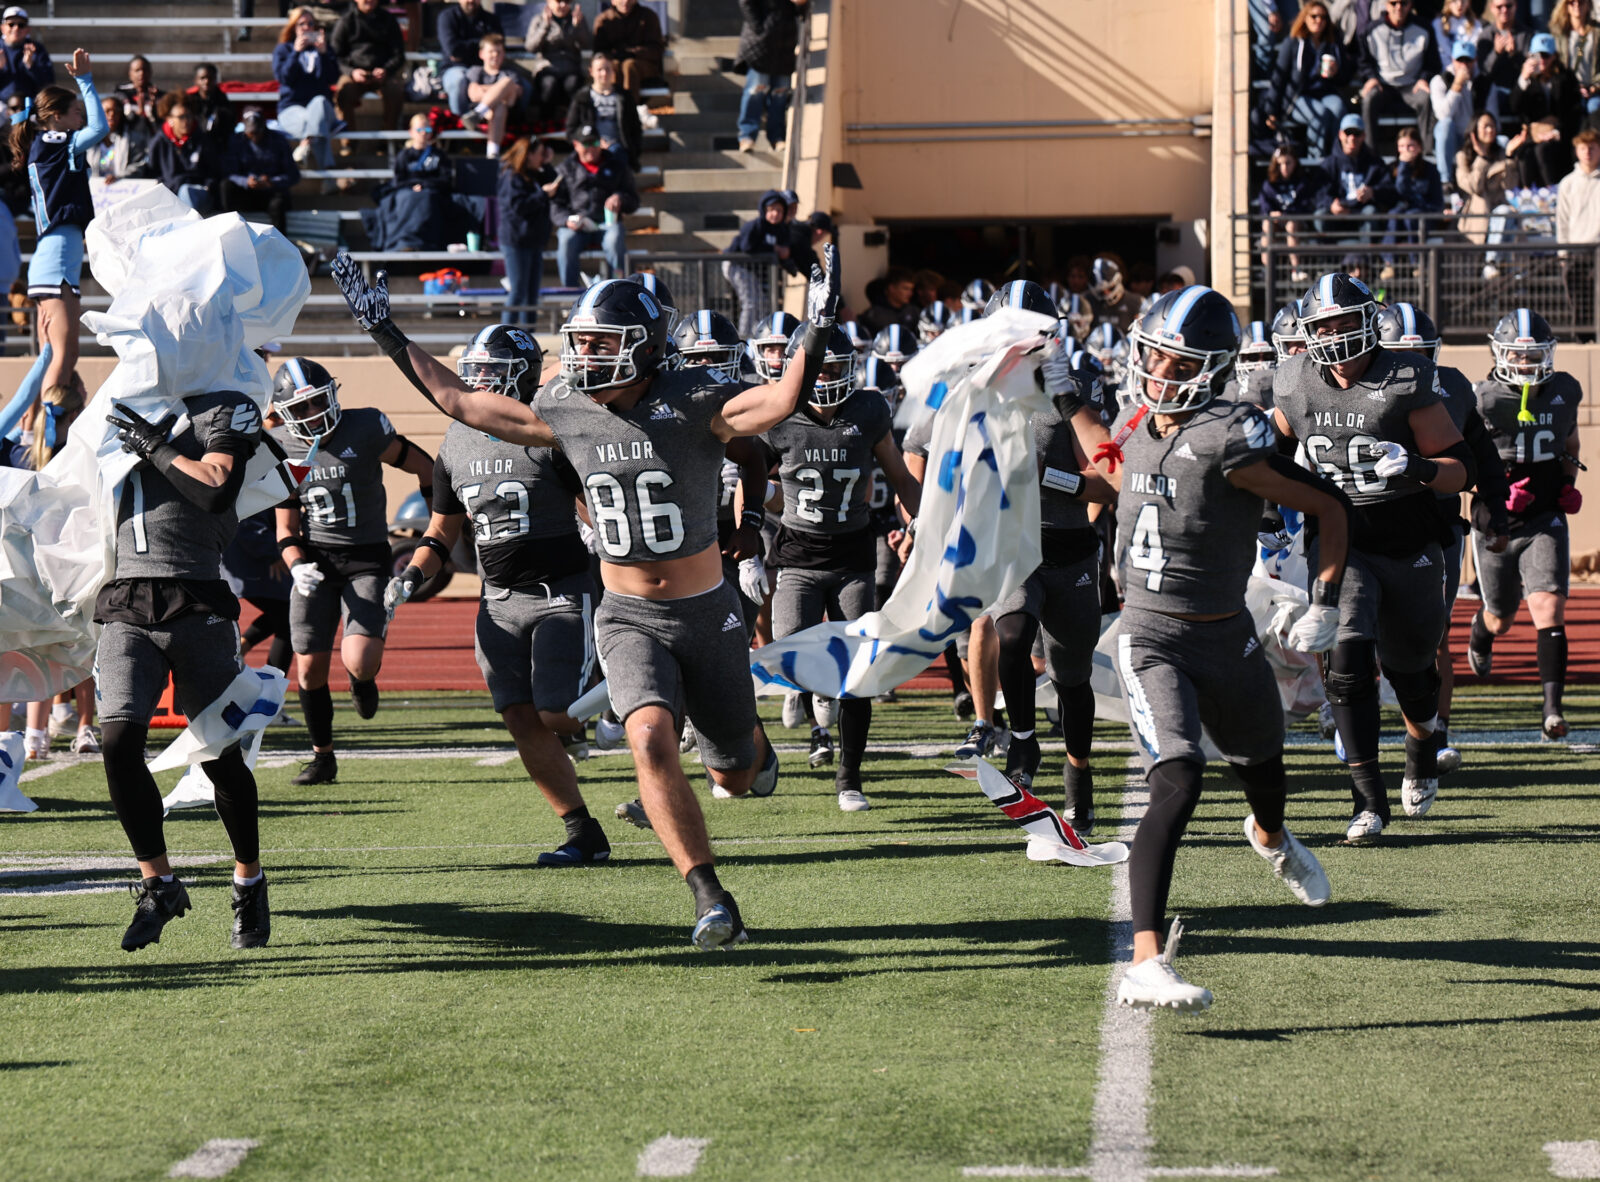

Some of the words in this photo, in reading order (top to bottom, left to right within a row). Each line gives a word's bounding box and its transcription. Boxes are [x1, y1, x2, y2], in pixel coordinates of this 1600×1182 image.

[506, 329, 534, 351] 53
[650, 411, 678, 420] adidas
[1314, 412, 1365, 429] VALOR
[596, 440, 654, 463] VALOR
[804, 448, 847, 462] VALOR
[469, 458, 513, 476] VALOR
[796, 467, 860, 524] 27
[1131, 472, 1178, 498] VALOR
[129, 469, 149, 554] 1
[460, 480, 531, 542] 53
[586, 469, 686, 557] 86
[1129, 501, 1171, 594] 4
